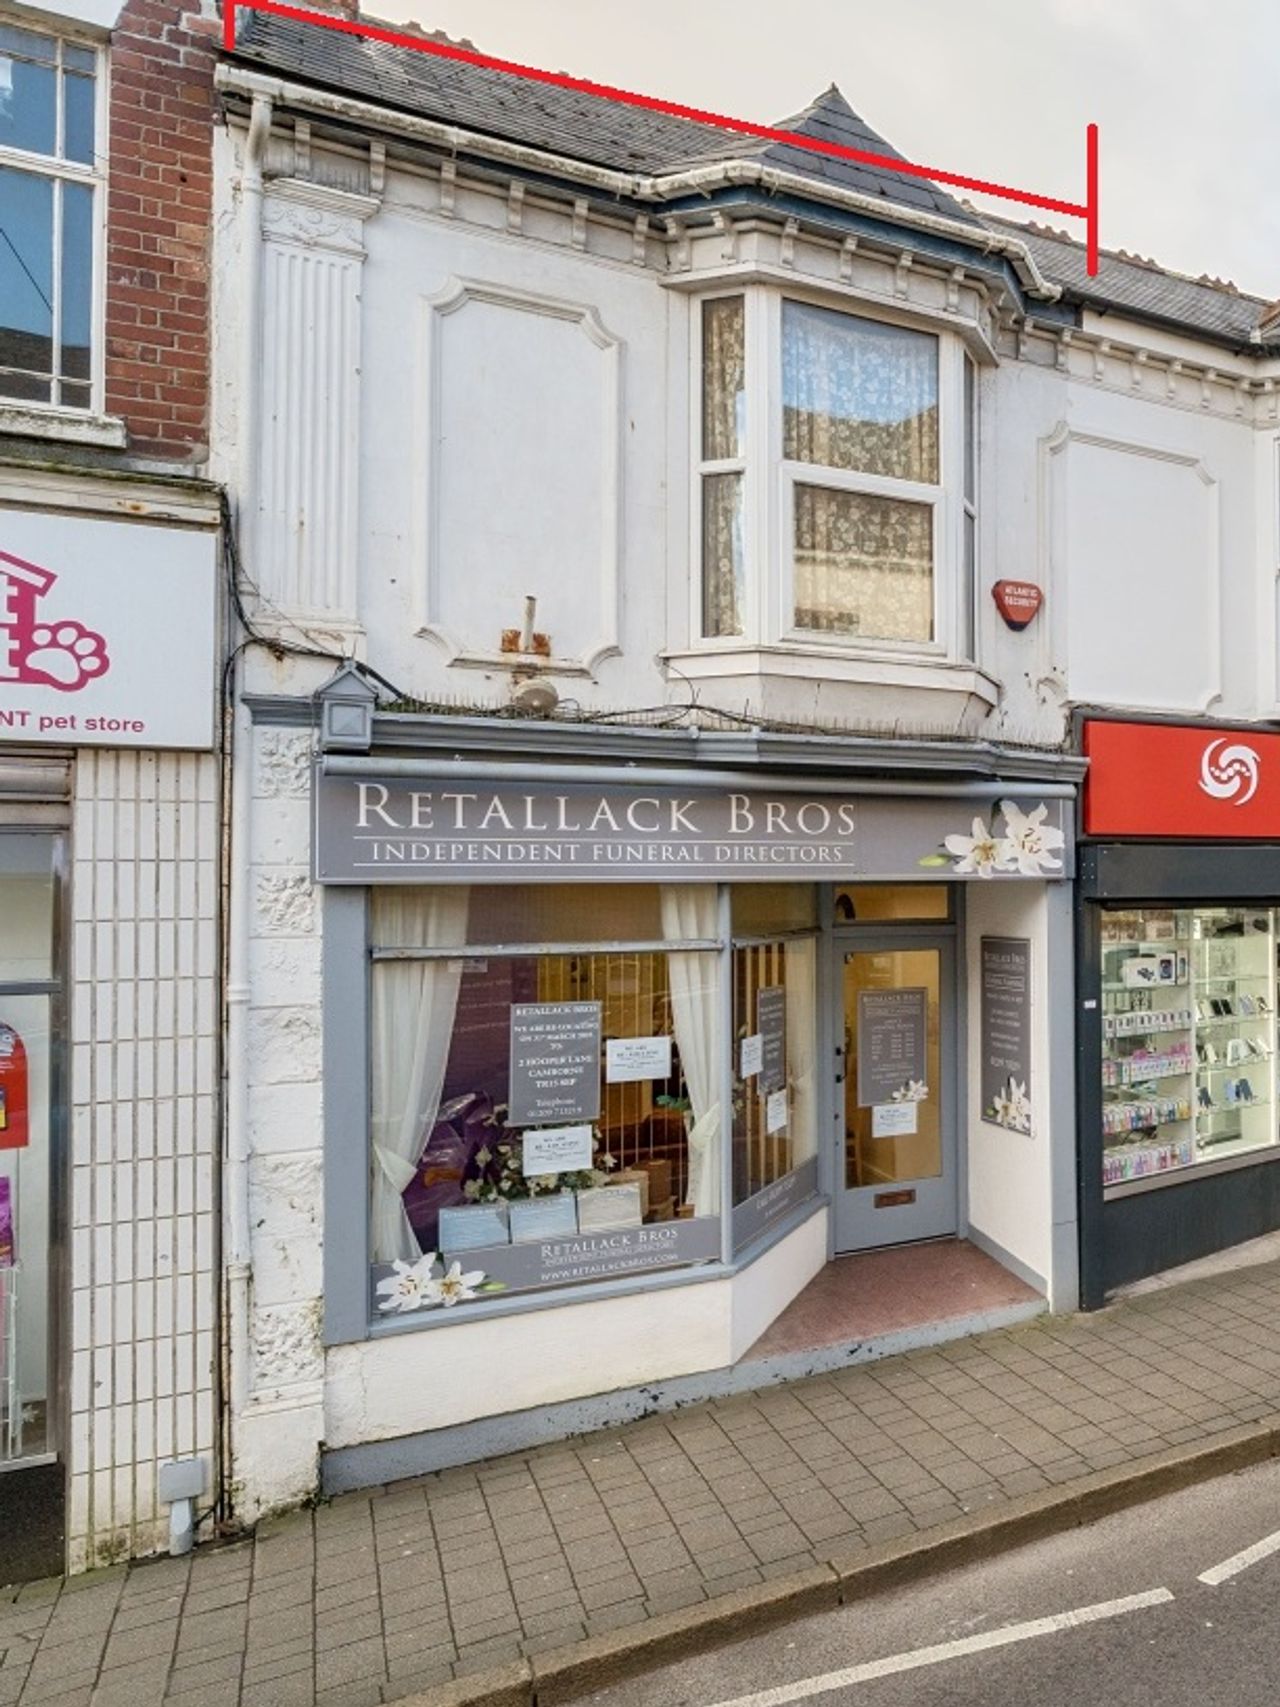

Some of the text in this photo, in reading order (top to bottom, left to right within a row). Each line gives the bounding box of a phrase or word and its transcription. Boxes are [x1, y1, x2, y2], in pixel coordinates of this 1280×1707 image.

[39, 714, 76, 732] pet
[84, 716, 145, 733] store
[352, 781, 856, 836] RETALLACK BROS
[371, 841, 845, 863] INDEPENDENT FUNERAL DIRECTORS
[541, 1228, 679, 1258] RETALLACK BROS
